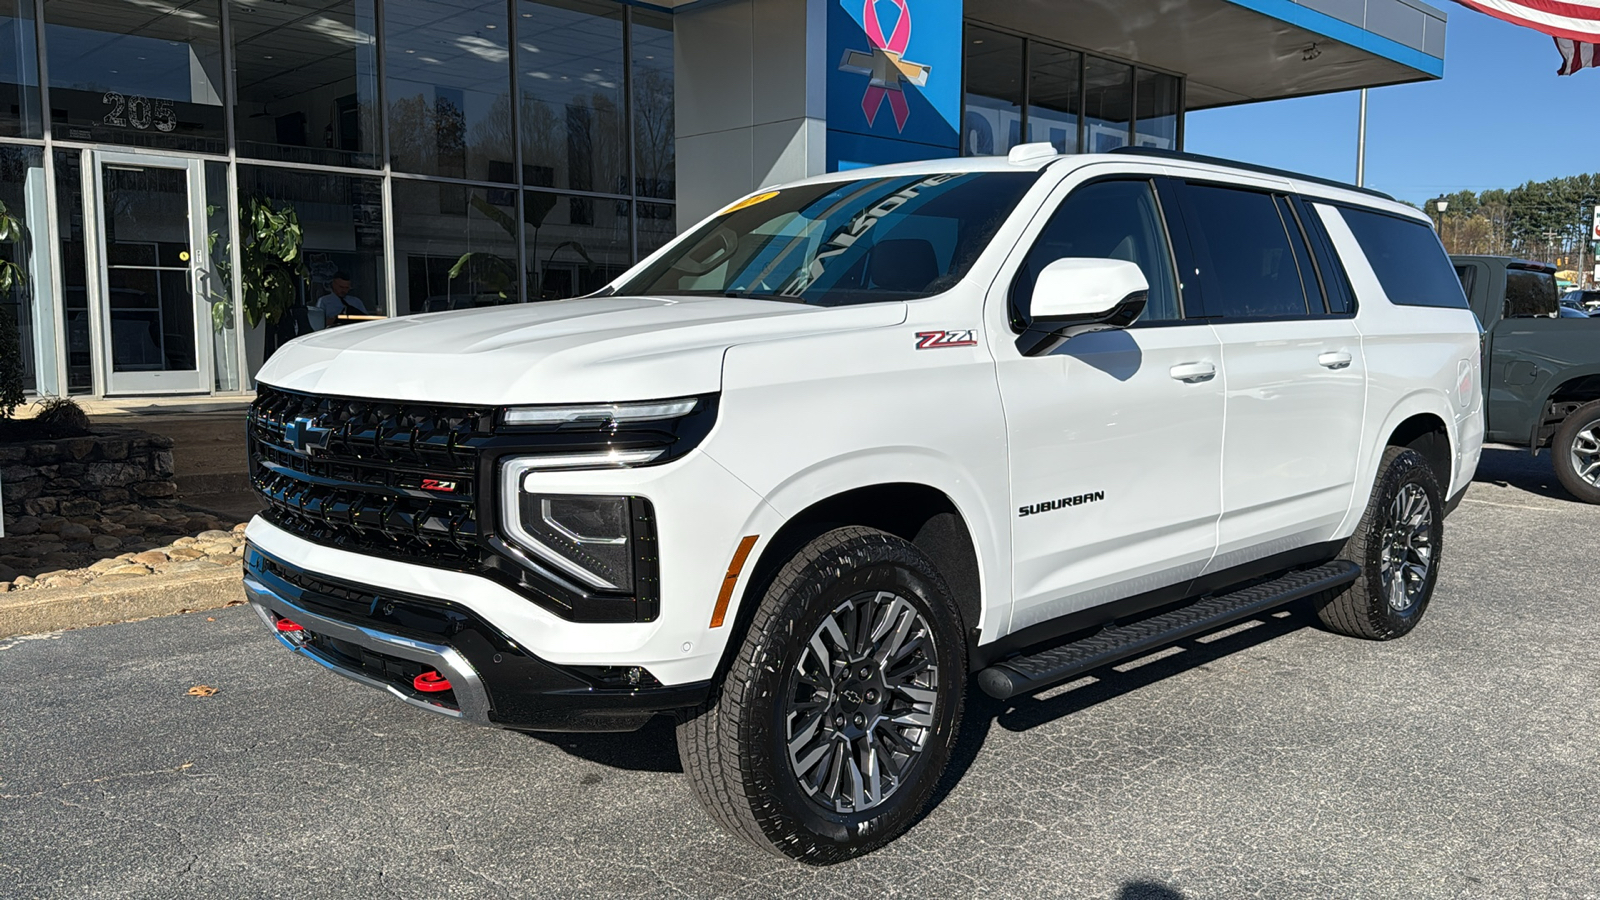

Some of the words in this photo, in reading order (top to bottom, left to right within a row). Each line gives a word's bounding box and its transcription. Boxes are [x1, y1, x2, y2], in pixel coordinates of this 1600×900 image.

[102, 90, 177, 132] 205
[915, 329, 978, 350] Z71
[421, 479, 456, 492] Z71
[1018, 490, 1105, 518] SUBURBAN
